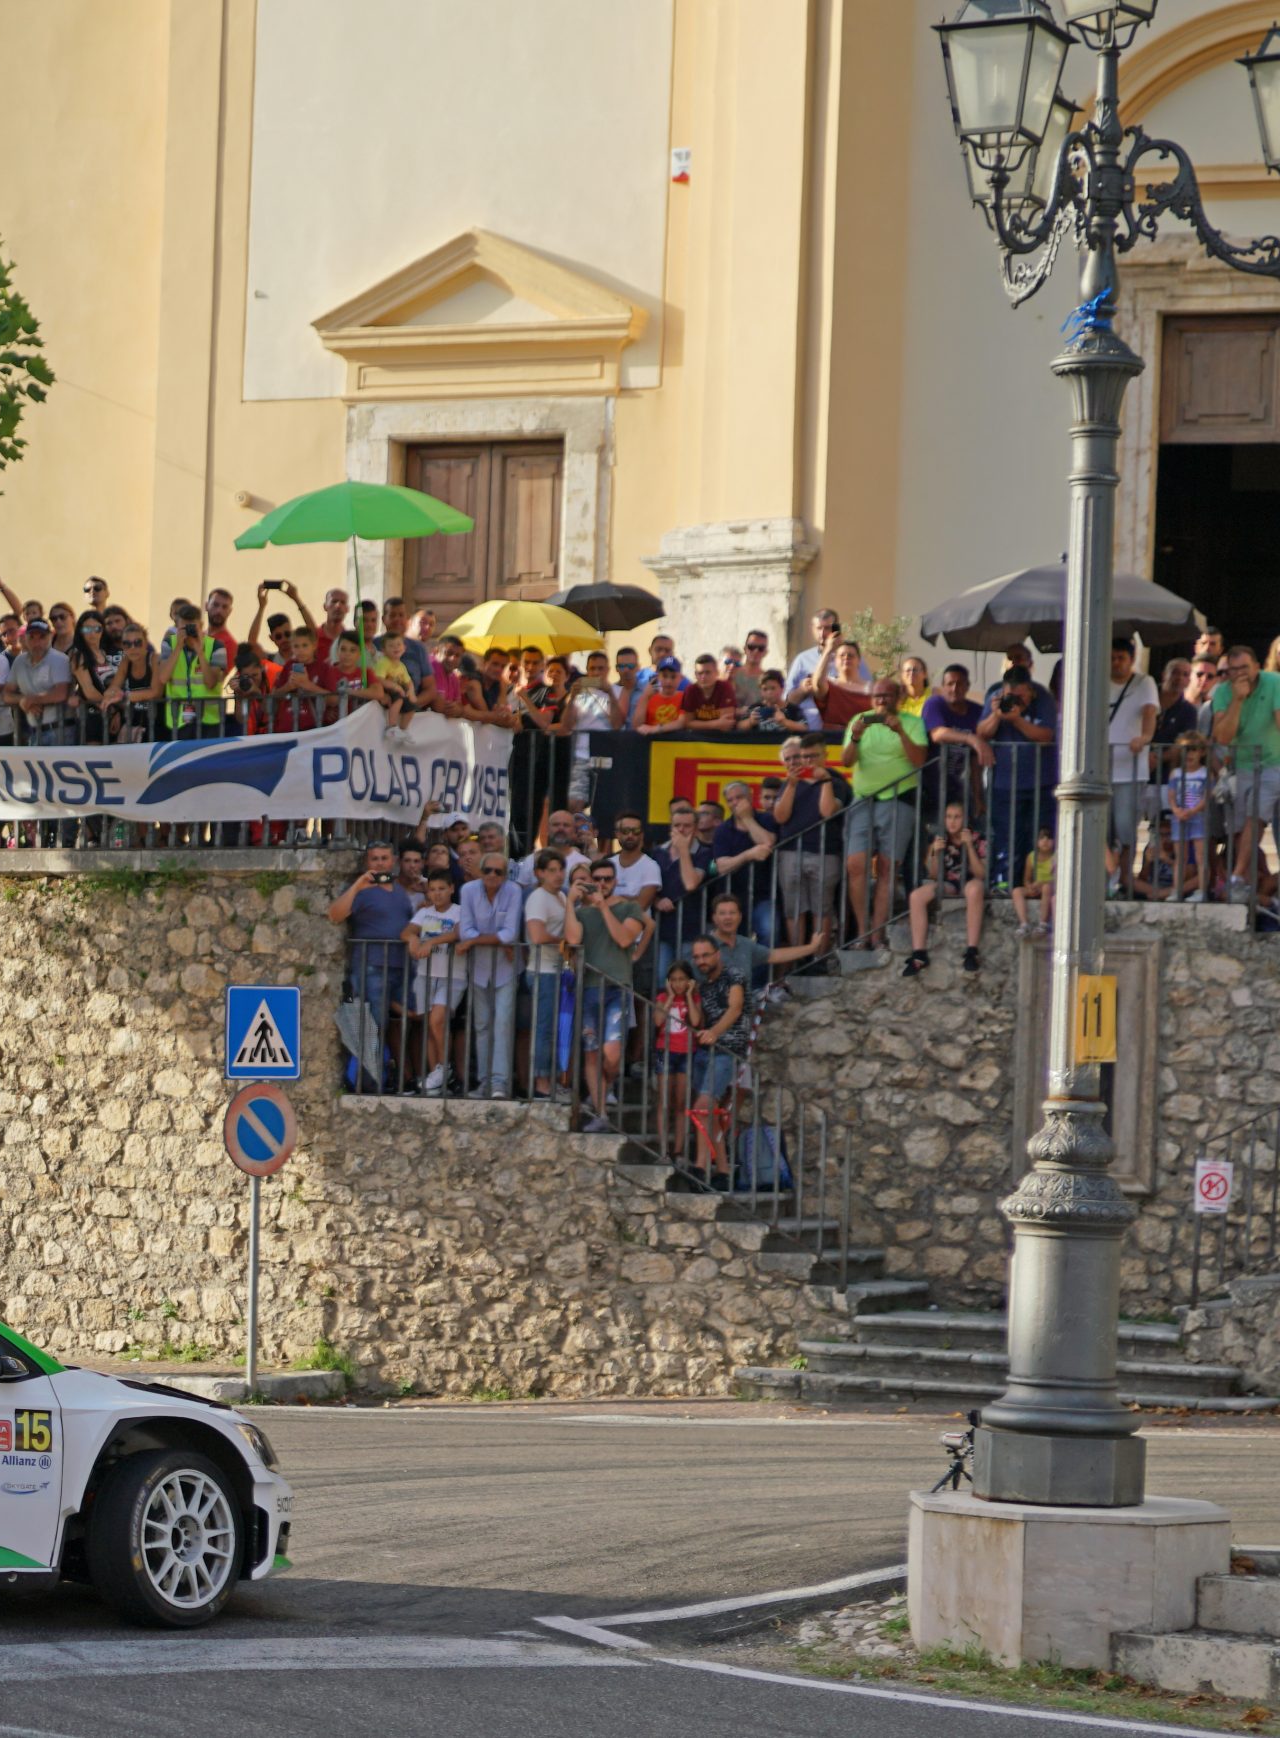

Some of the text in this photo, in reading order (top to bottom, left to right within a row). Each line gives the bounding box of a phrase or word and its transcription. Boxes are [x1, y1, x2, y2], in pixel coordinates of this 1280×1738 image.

[312, 746, 508, 818] POLAR CRUISE
[1081, 992, 1102, 1038] 11
[16, 1410, 51, 1451] 15
[1, 1455, 37, 1466] Allianz
